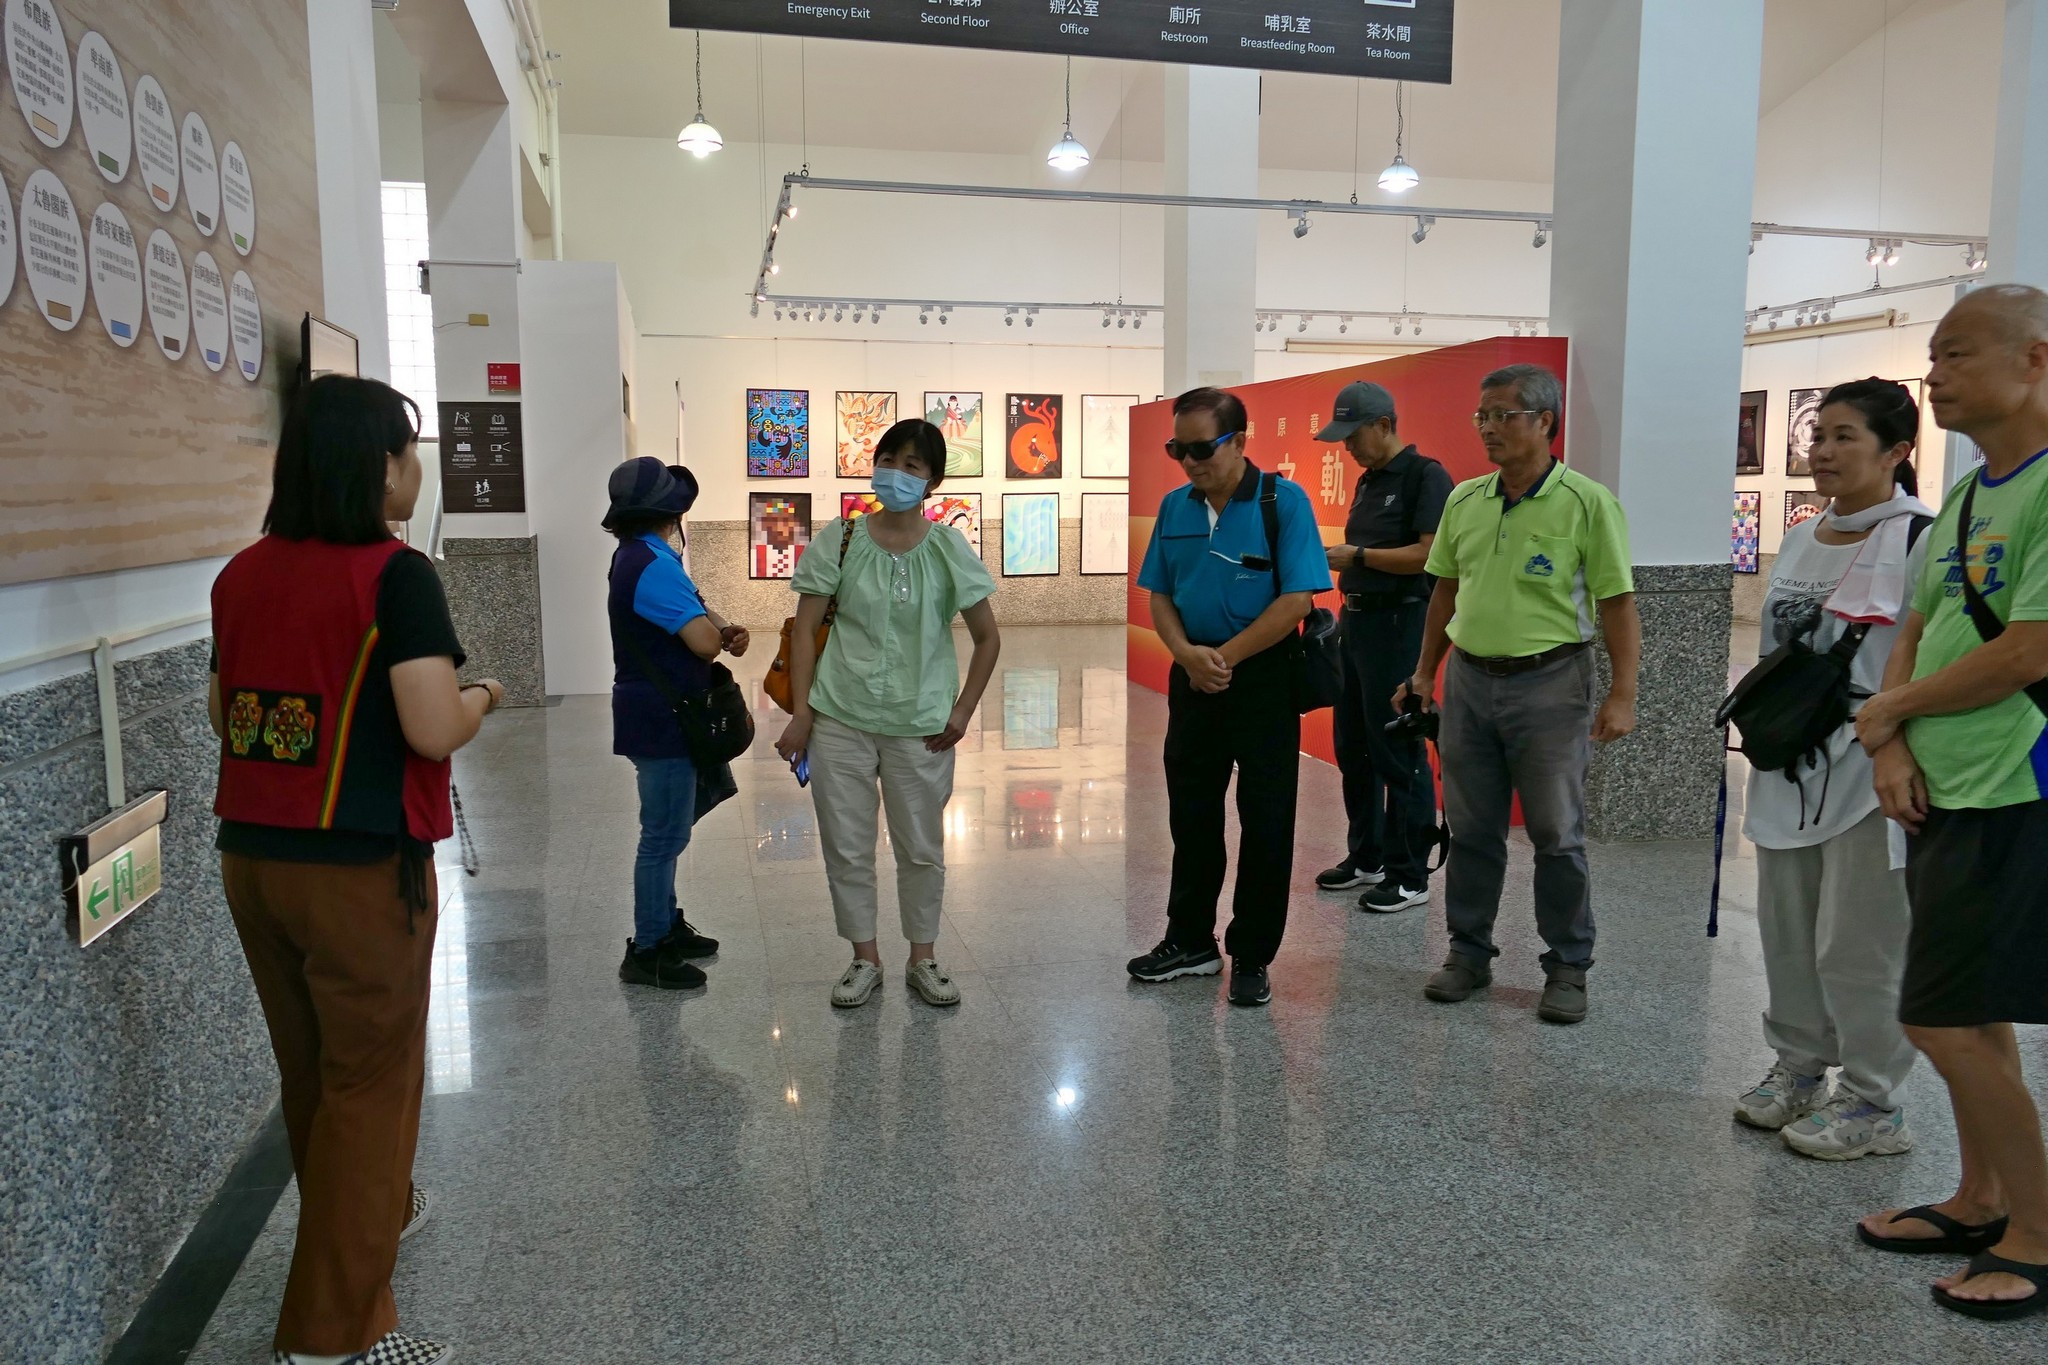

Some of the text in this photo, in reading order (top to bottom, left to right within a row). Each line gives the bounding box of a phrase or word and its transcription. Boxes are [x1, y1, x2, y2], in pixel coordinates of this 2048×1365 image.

[787, 2, 871, 19] Emergency Exit
[1049, 0, 1099, 17] 辦公室
[1168, 6, 1201, 25] 廁所
[920, 12, 990, 28] Second Floor
[1264, 14, 1312, 34] 哺乳室
[1059, 23, 1090, 36] Office
[1161, 30, 1208, 44] Restroom
[1365, 22, 1411, 43] 茶水間
[1240, 37, 1336, 55] Breastfeeding Room
[1365, 47, 1411, 60] Tea Room
[32, 184, 70, 221] 太魯閣族
